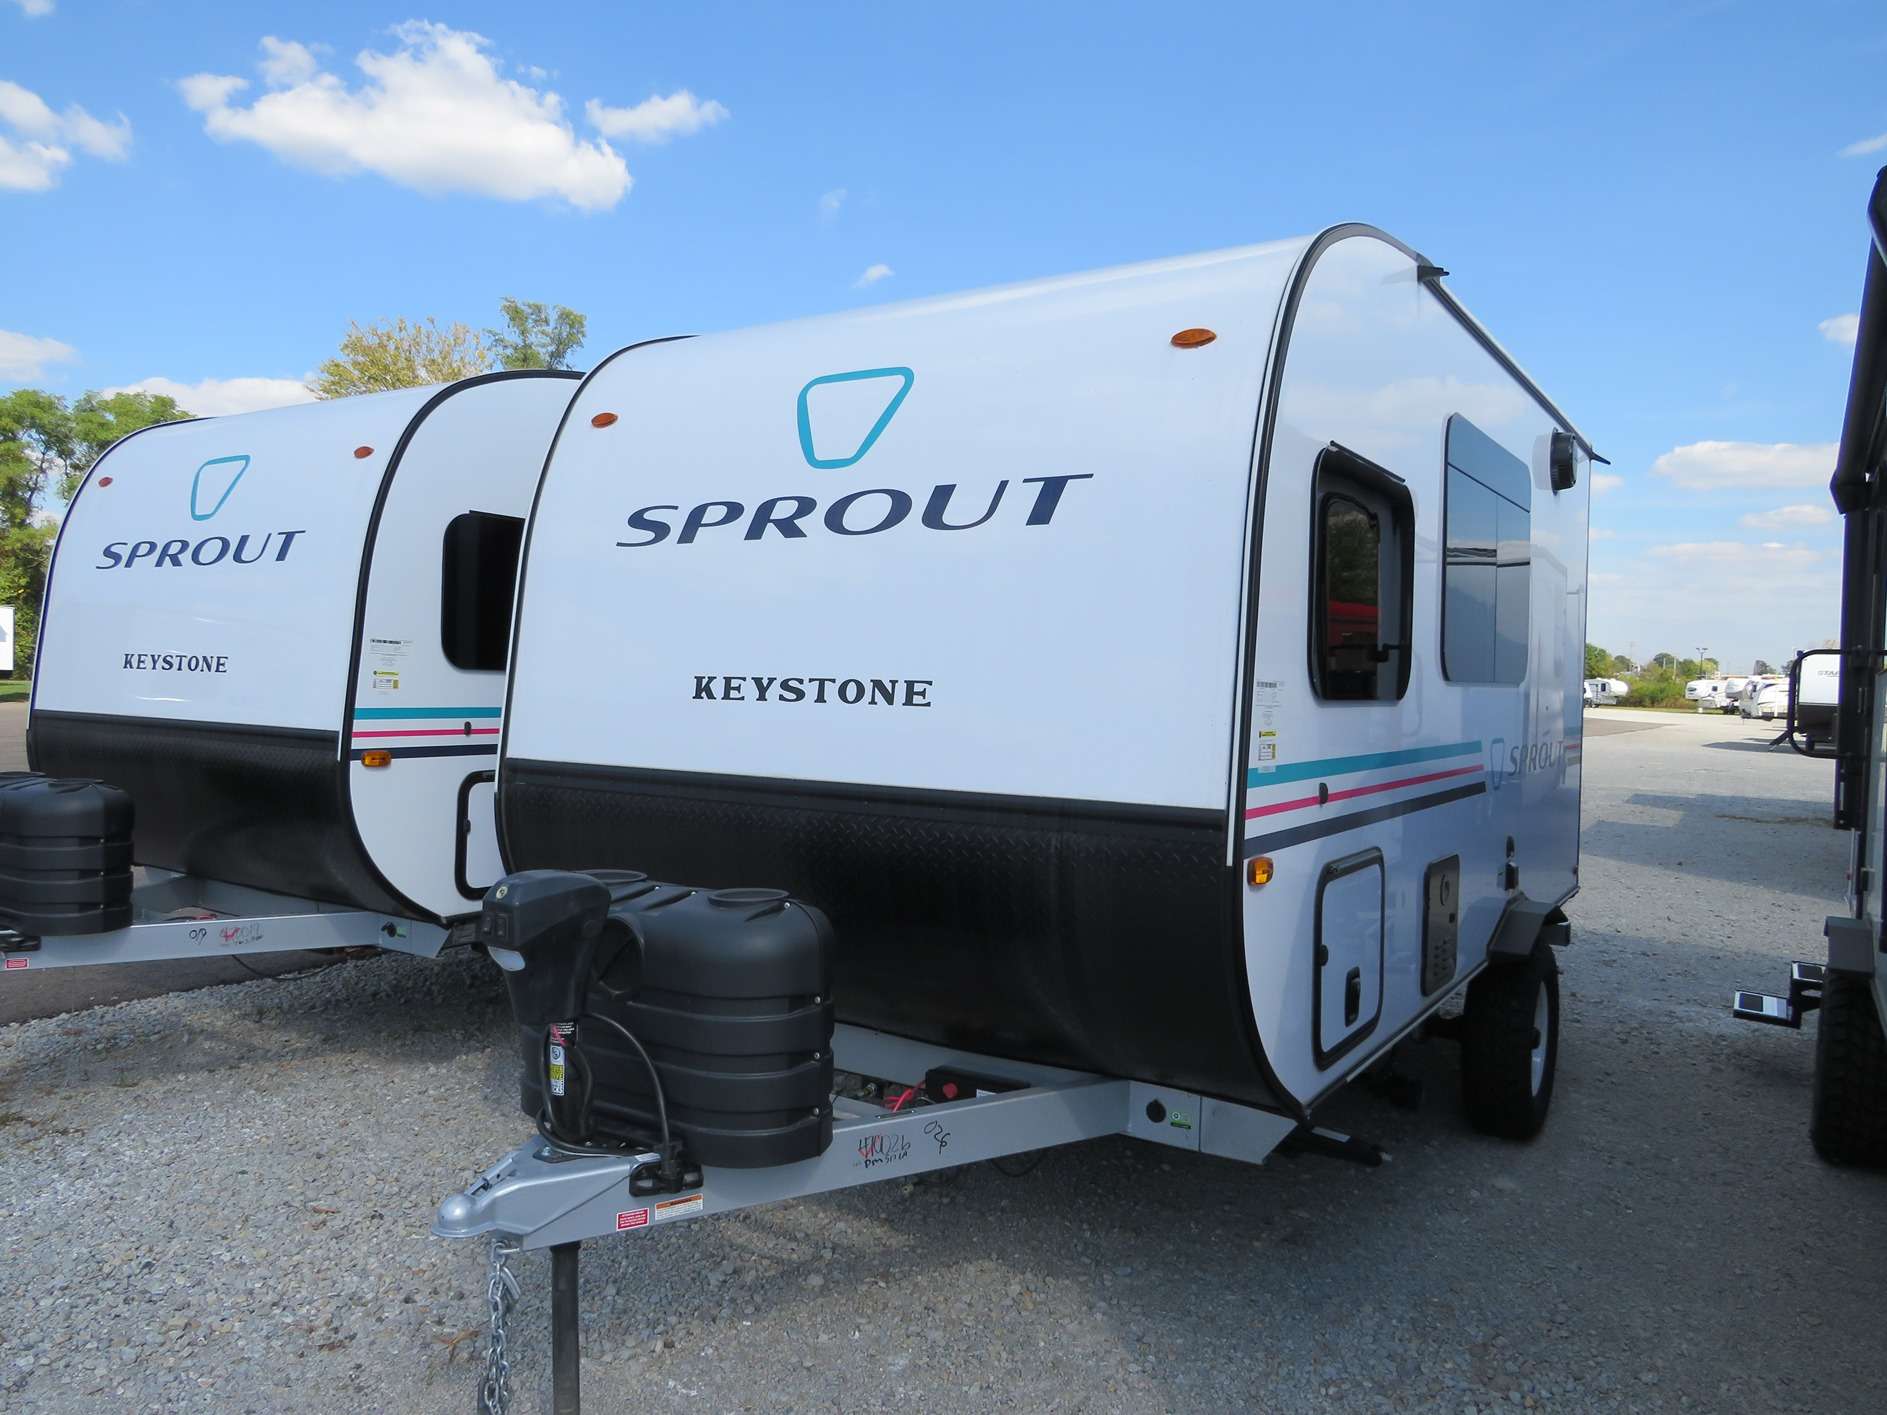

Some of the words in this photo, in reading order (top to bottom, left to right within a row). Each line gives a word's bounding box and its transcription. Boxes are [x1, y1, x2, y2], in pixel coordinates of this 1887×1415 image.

[615, 472, 1095, 548] SPROUT
[95, 529, 307, 570] SPROUT
[122, 653, 229, 673] KEYSTONE
[692, 675, 933, 708] KEYSTONE
[1507, 740, 1566, 777] SPROUT
